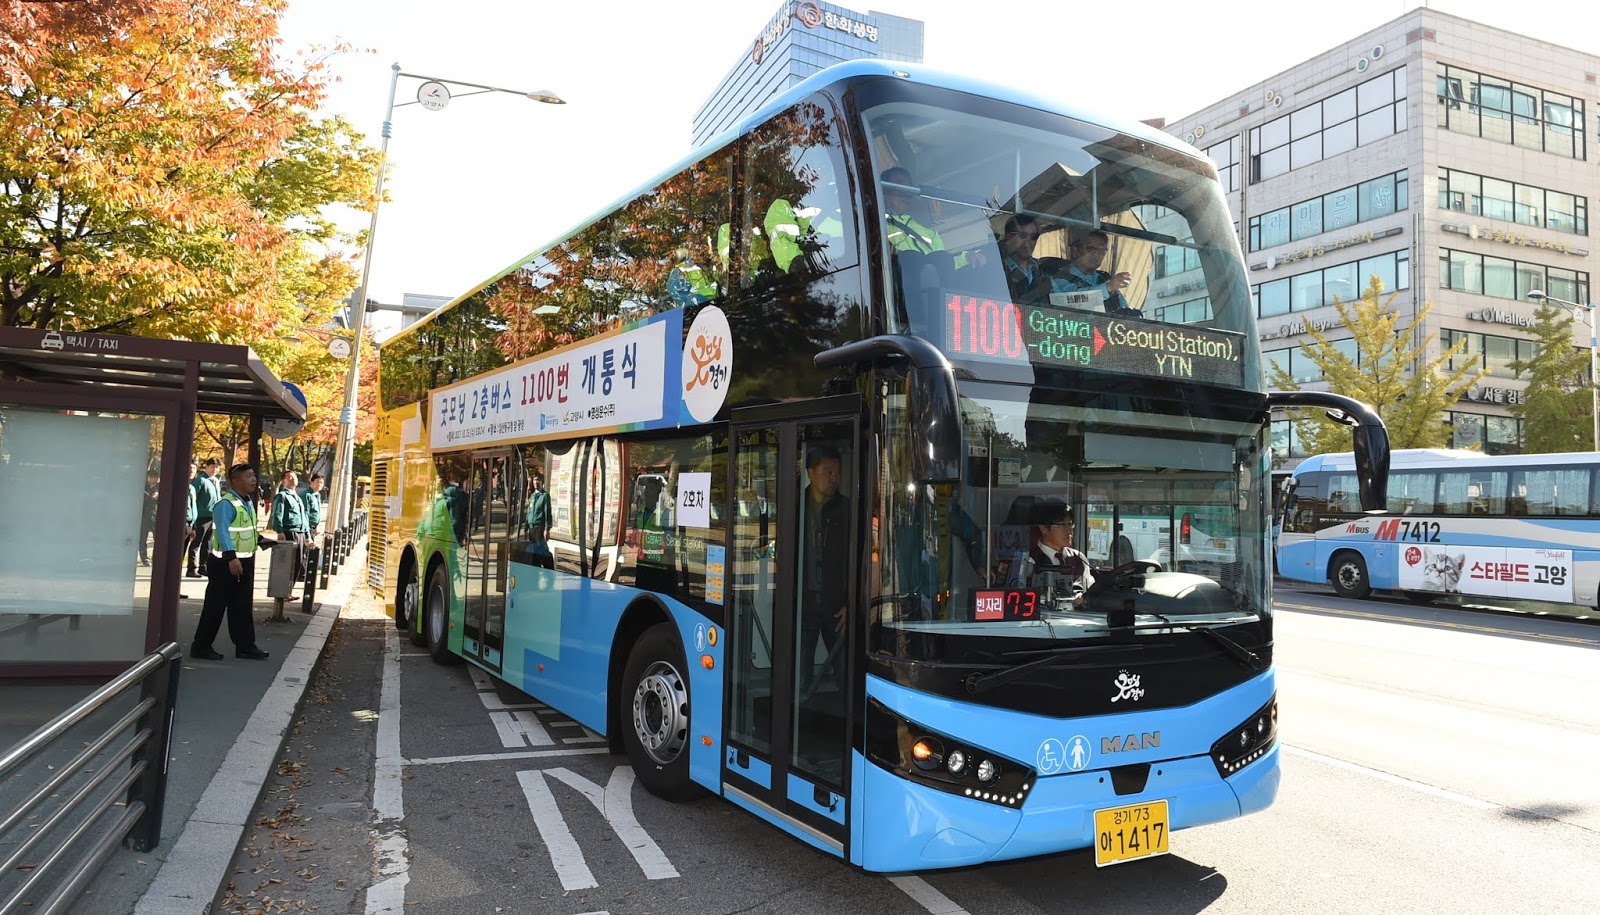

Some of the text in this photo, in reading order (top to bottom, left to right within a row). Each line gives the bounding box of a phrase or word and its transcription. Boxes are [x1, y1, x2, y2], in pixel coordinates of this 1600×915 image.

[825, 11, 878, 42] 한화생명
[948, 294, 1022, 358] 1100
[1029, 310, 1092, 339] Gajwa
[1280, 320, 1327, 338] O'Maley
[66, 335, 87, 348] 택시
[98, 338, 119, 350] TAXI
[1028, 336, 1092, 365] -dong
[709, 364, 728, 390] 경기
[1155, 355, 1193, 378] YTN
[440, 342, 637, 428] 굿모닝 2층버스 1100번 개통식
[1484, 387, 1503, 403] 서울
[570, 411, 584, 422] 고양시
[683, 490, 704, 509] 2호차
[1470, 561, 1567, 586] 스타필드 고양
[976, 591, 1036, 617] 빈자리 73
[1130, 688, 1145, 701] 경기
[1101, 730, 1160, 754] MAN
[1113, 807, 1150, 825] 경기 73
[1100, 822, 1164, 855] 아 1417
